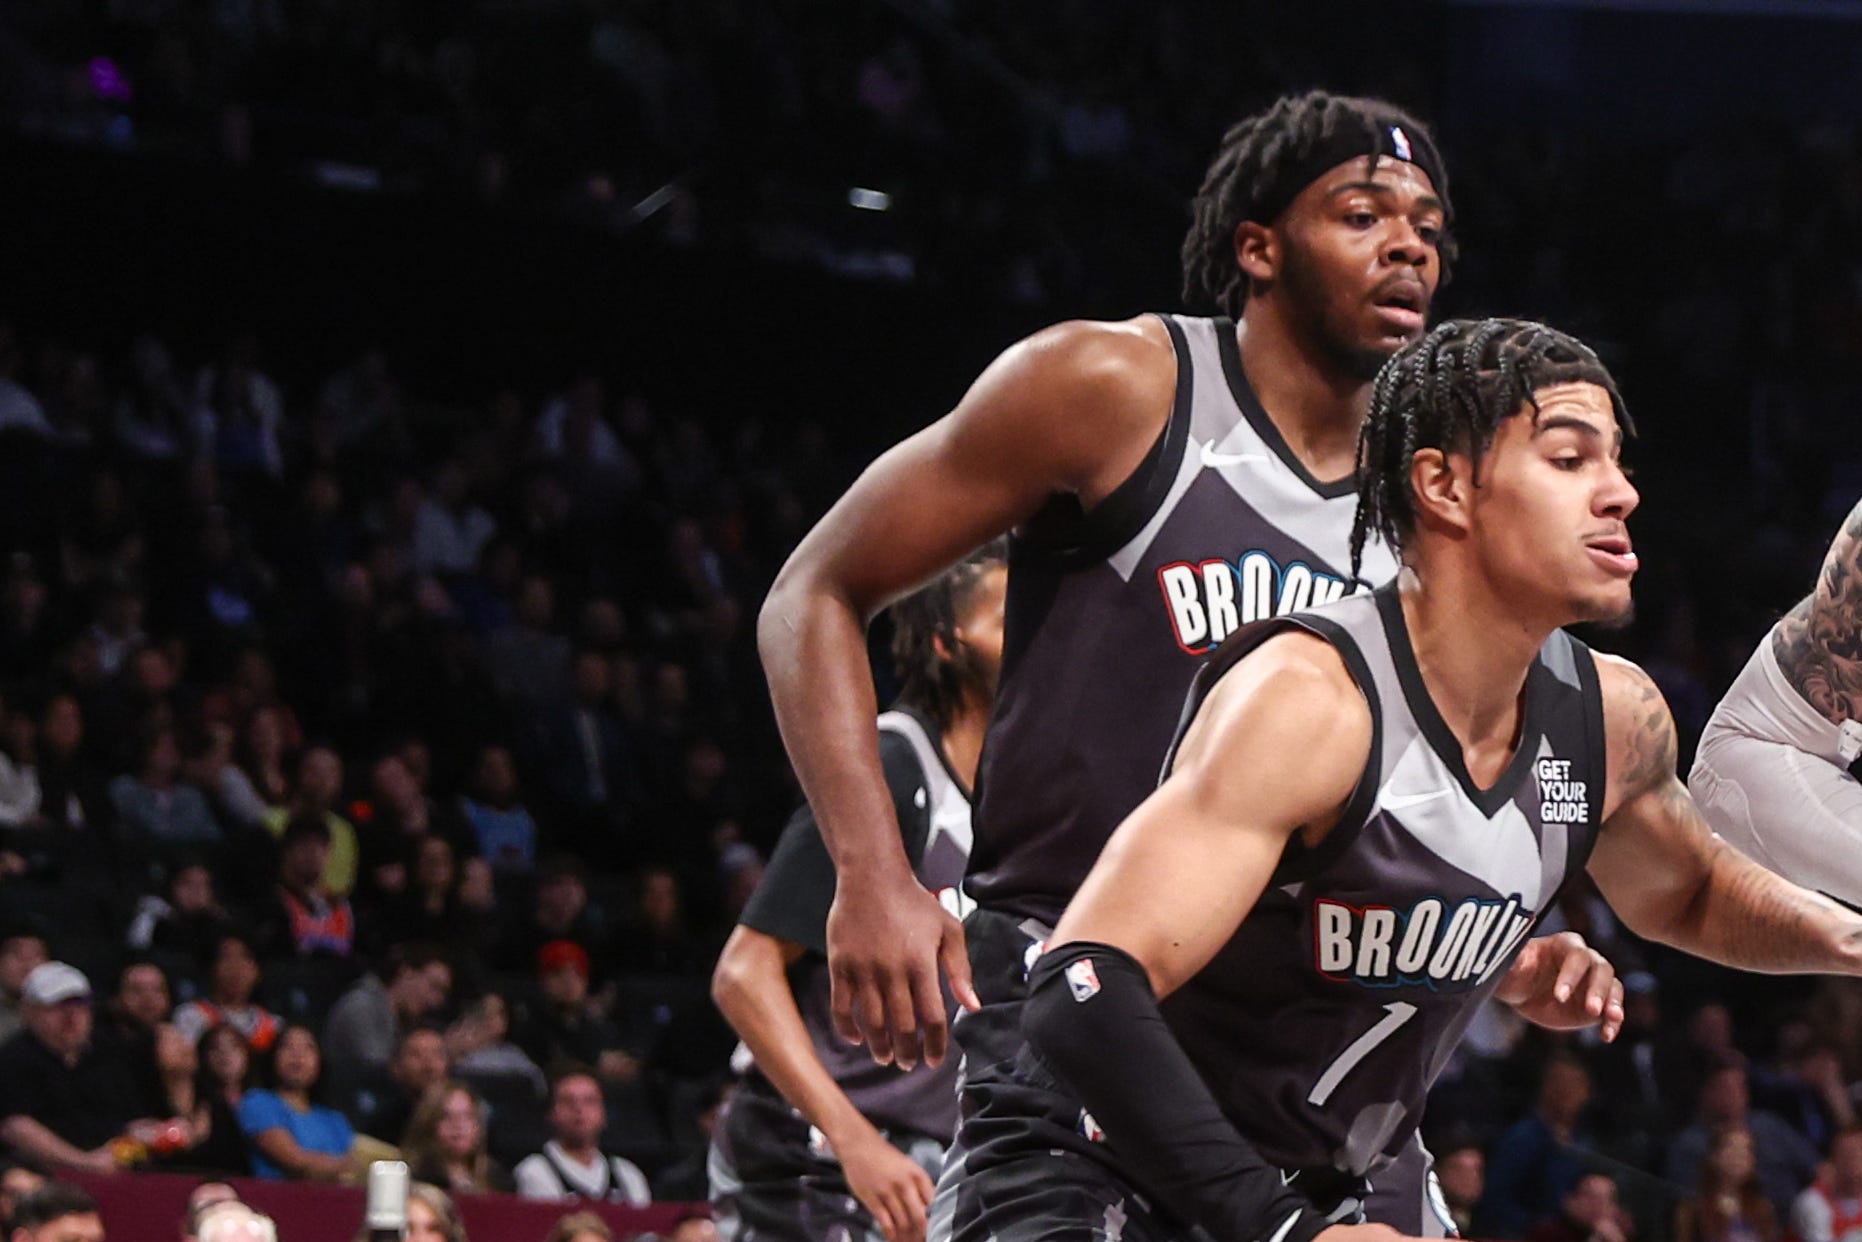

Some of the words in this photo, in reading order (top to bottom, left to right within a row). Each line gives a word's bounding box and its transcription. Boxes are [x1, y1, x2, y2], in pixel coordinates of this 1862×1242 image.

[1538, 759, 1571, 780] GET
[1540, 780, 1587, 802] YOUR
[1541, 801, 1589, 823] GUIDE
[1317, 897, 1536, 986] BROOKLY
